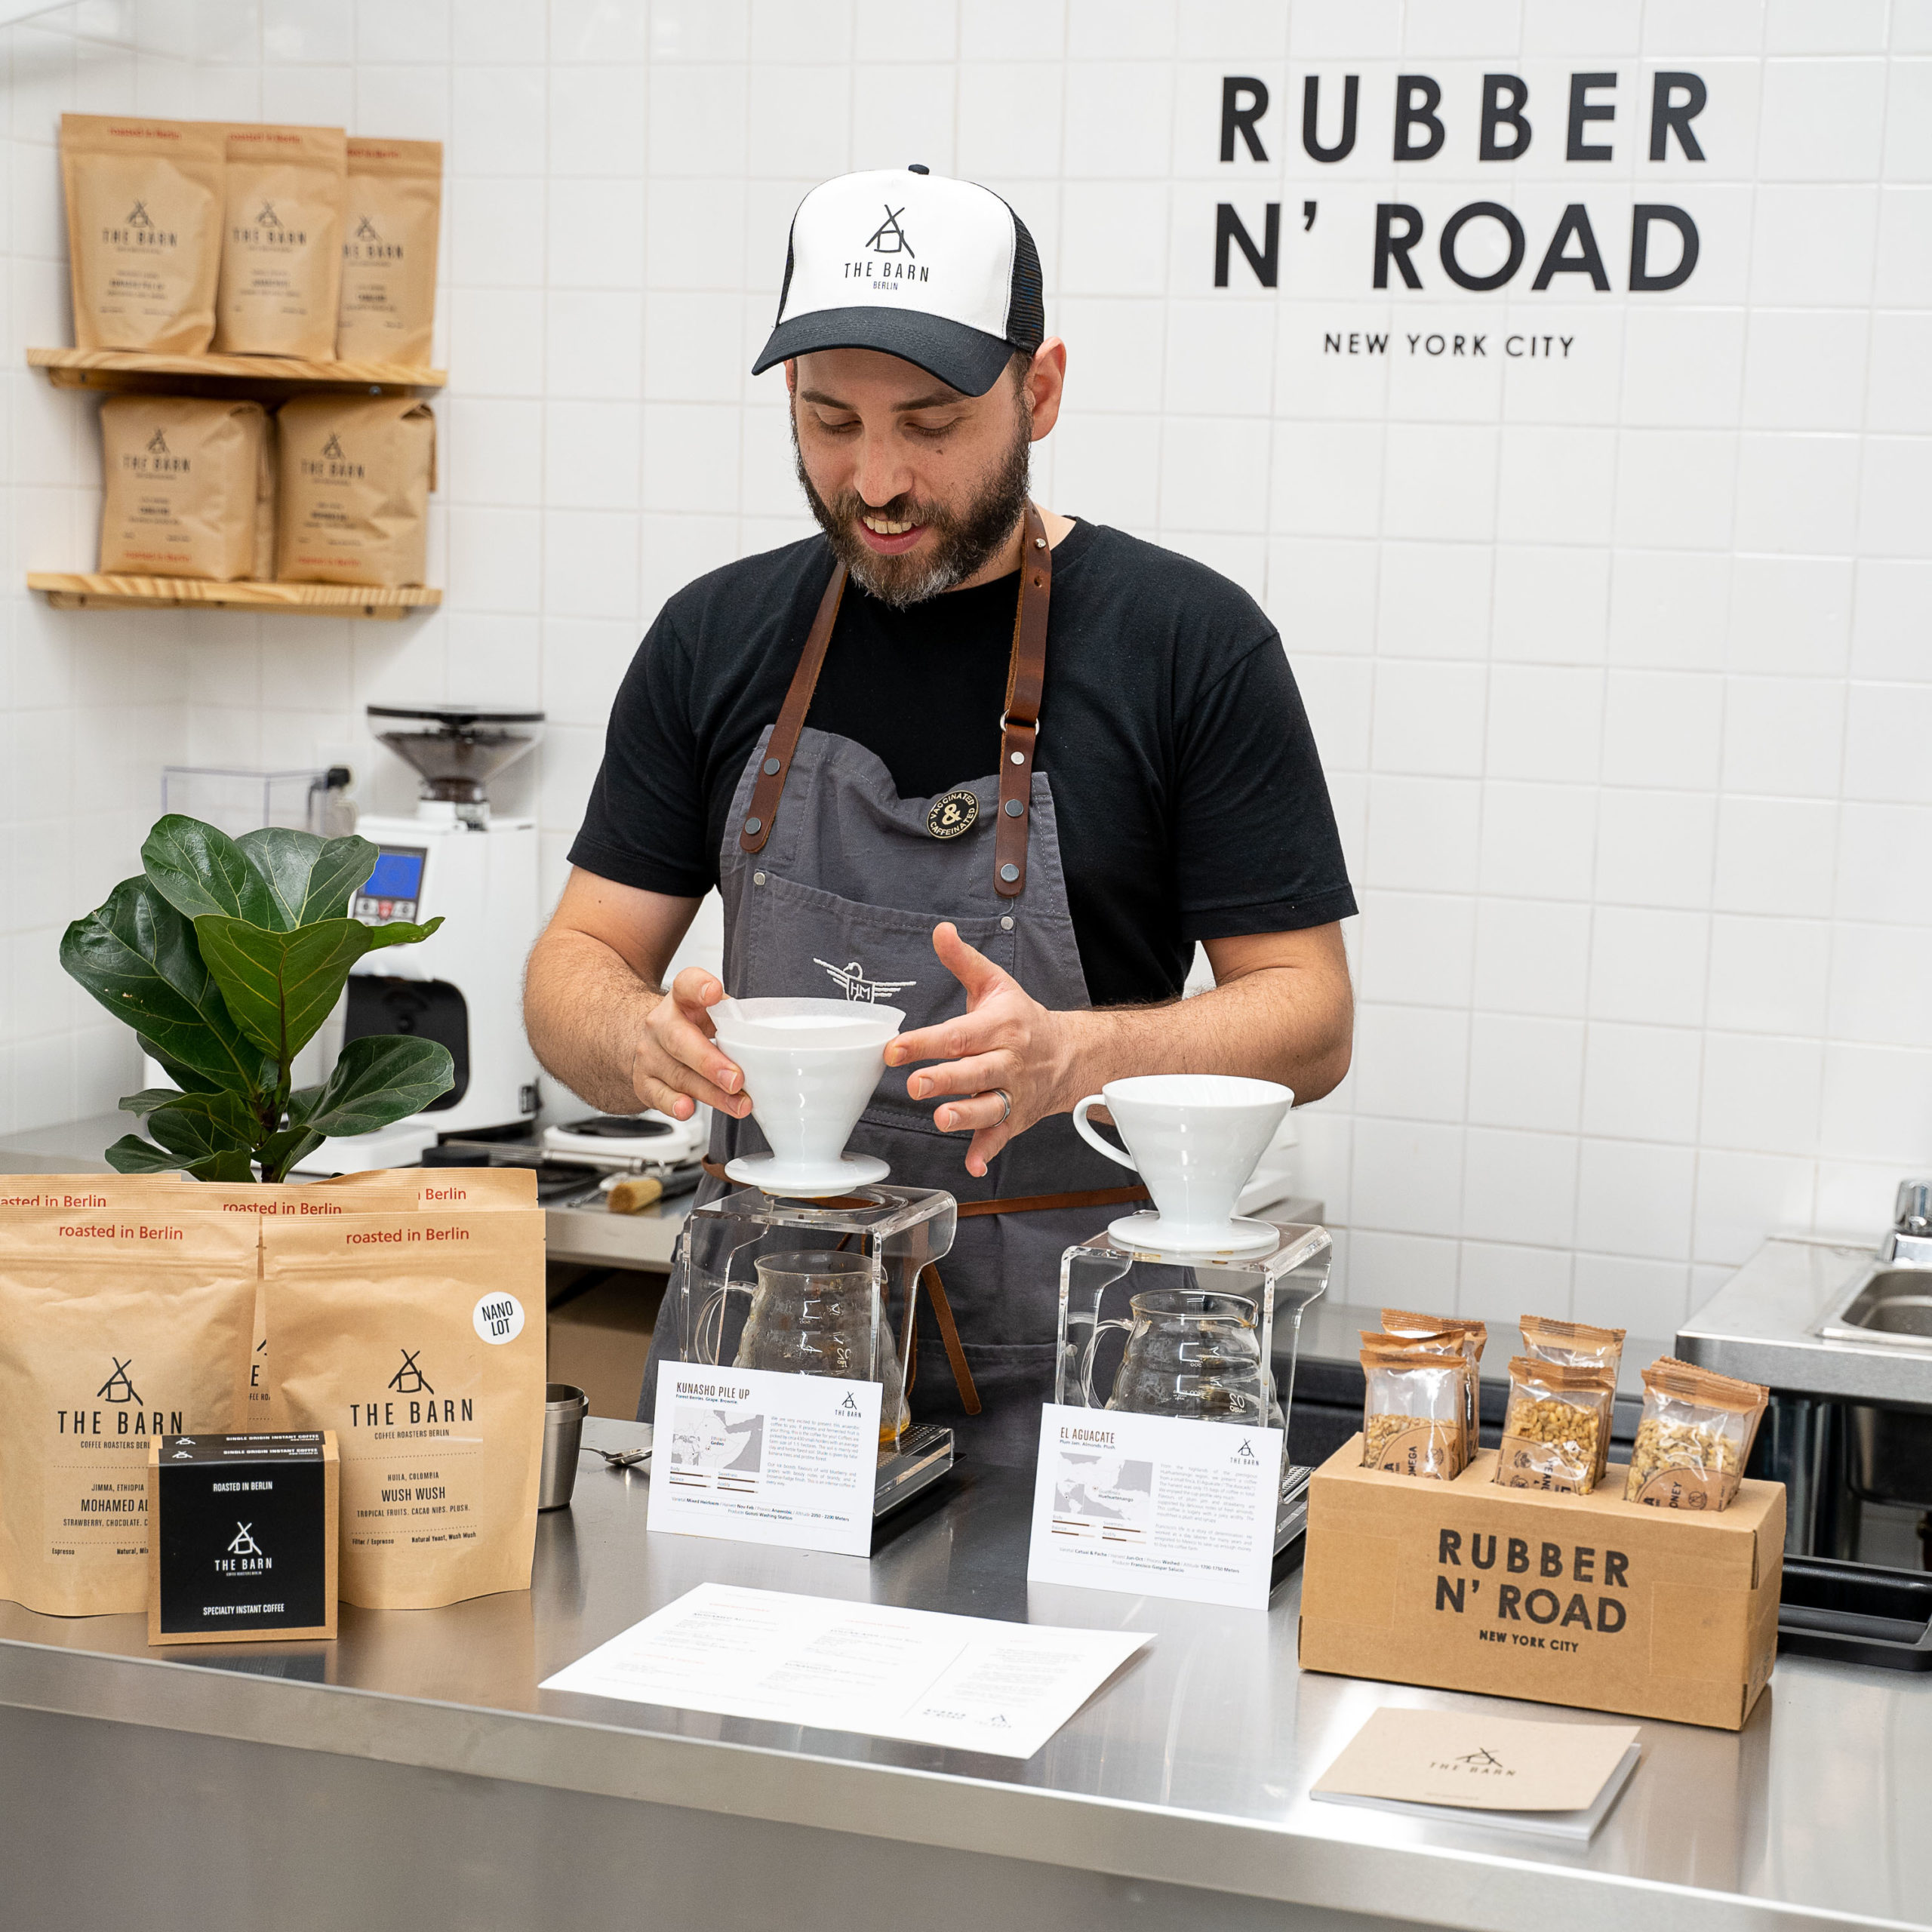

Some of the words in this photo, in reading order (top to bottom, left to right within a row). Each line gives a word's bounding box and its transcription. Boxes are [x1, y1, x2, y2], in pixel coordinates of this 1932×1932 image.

[1220, 72, 1707, 162] RUBBER
[103, 228, 128, 246] THE
[138, 229, 177, 247] BARN
[233, 227, 259, 244] THE
[269, 228, 306, 245] BARN
[366, 244, 404, 260] BARN
[1373, 202, 1700, 291] ROAD
[844, 262, 872, 278] THE
[883, 263, 929, 282] BARN
[873, 281, 898, 290] BERLIN
[1324, 333, 1389, 355] NEW
[1407, 334, 1487, 356] YORK
[1505, 336, 1576, 357] CITY
[931, 793, 975, 819] VACCINATED
[931, 808, 975, 835] CAFFEINATED
[0, 1195, 40, 1206] asted
[45, 1195, 58, 1208] in
[63, 1195, 106, 1208] Berlin
[425, 1187, 466, 1200] Berlin
[282, 1201, 295, 1214] in
[300, 1202, 342, 1215] Berlin
[59, 1224, 115, 1238] roasted
[120, 1225, 134, 1239] in
[139, 1226, 183, 1240] Berlin
[346, 1229, 402, 1244] roasted
[407, 1229, 420, 1241] in
[426, 1227, 469, 1241] Berlin
[481, 1300, 514, 1321] NANO
[491, 1318, 509, 1337] LOT
[676, 1382, 715, 1396] KUNASHO
[718, 1386, 736, 1399] PILE
[738, 1389, 750, 1400] UP
[350, 1402, 394, 1427] THE
[410, 1398, 472, 1424] BARN
[847, 1410, 862, 1418] BARN
[57, 1411, 101, 1434] THE
[117, 1411, 183, 1435] BARN
[374, 1432, 395, 1440] COFFEE
[397, 1430, 427, 1439] ROASTERS
[429, 1429, 450, 1438] BERLIN
[1060, 1426, 1069, 1439] EL
[1072, 1429, 1115, 1444] AGUACATE
[81, 1441, 102, 1449] COFFEE
[103, 1441, 135, 1449] ROASTERS
[136, 1441, 150, 1450] BERL
[1230, 1457, 1241, 1465] THE
[1244, 1458, 1260, 1466] BARN
[387, 1473, 408, 1482] HUILA,
[409, 1472, 439, 1481] COLOMBIA
[91, 1484, 115, 1493] JIMMA,
[116, 1484, 145, 1492] ETHIOPIA
[213, 1482, 241, 1492] ROASTED
[242, 1481, 249, 1491] IN
[251, 1481, 273, 1491] BERLIN
[381, 1488, 411, 1503] WUSH
[415, 1486, 446, 1500] WUSH
[1669, 1481, 1683, 1509] ONEY
[81, 1499, 134, 1512] MOHAMED
[137, 1499, 149, 1512] AL
[357, 1508, 384, 1518] TROPICAL
[411, 1506, 430, 1515] CACAO
[352, 1537, 365, 1546] Filter
[371, 1537, 395, 1546] Espresso
[411, 1535, 431, 1543] Natural
[432, 1534, 448, 1543] Yeast,
[51, 1547, 75, 1555] Espresso
[116, 1547, 138, 1555] Natural,
[1438, 1528, 1629, 1588] RUBBER
[214, 1558, 236, 1571] THE
[242, 1557, 272, 1570] BARN
[203, 1605, 235, 1616] SPECIALTY
[235, 1604, 262, 1615] INSTANT
[263, 1603, 285, 1613] COFFEE
[1498, 1583, 1626, 1633] ROAD
[1479, 1629, 1507, 1644] NEW
[1512, 1634, 1546, 1648] YORK
[1550, 1639, 1579, 1653] CITY
